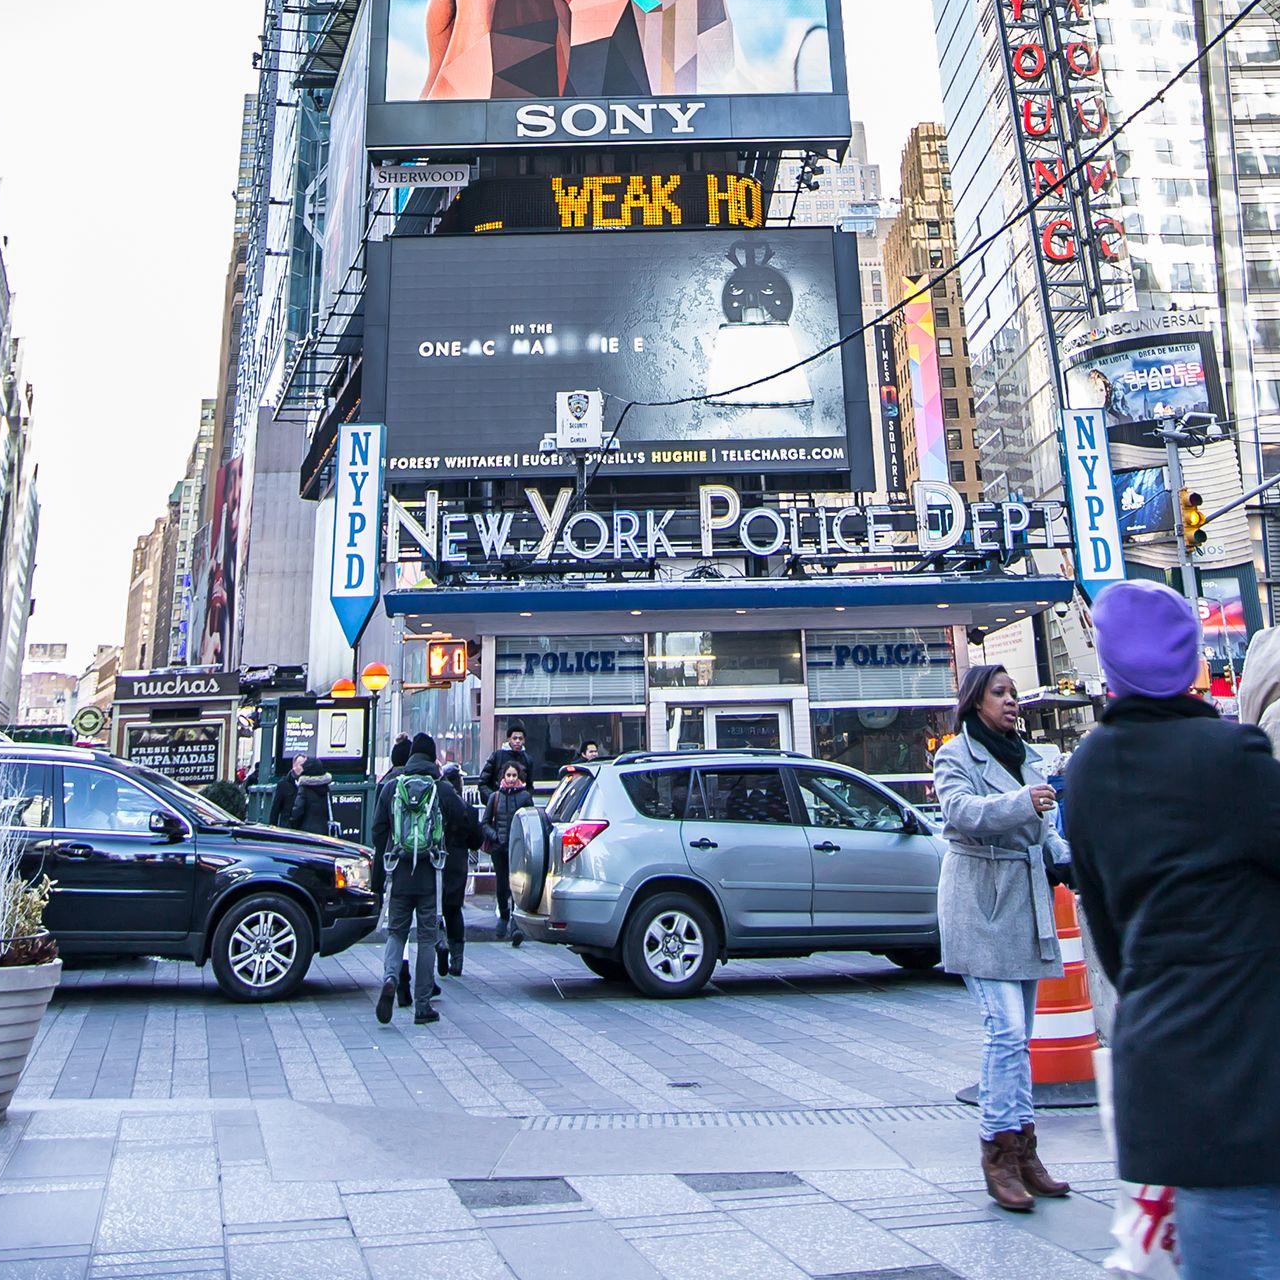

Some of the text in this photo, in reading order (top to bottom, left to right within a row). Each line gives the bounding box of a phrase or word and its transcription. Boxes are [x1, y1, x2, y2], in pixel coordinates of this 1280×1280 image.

[516, 103, 706, 137] SONY
[377, 167, 466, 185] SHERWOOD
[551, 174, 683, 227] WEAK
[510, 323, 553, 334] IN THE
[1105, 314, 1204, 336] NBCUNIVERSAL
[879, 328, 892, 382] TIMES
[1138, 349, 1156, 358] DREA
[1168, 344, 1197, 353] MATTEO
[1123, 362, 1201, 383] SHADES
[1129, 373, 1199, 392] OF BLUE
[389, 447, 845, 470] FOREST WHITAKER HUGHIE TELECHARGE.COM
[887, 420, 899, 488] SQUARE
[1072, 414, 1113, 573] NYPD
[343, 431, 372, 590] NYPD
[386, 479, 1065, 563] NEW YORK POLICE DEPT
[523, 650, 619, 675] POLICE
[833, 642, 928, 668] POLICE
[133, 676, 220, 695] nuchas
[131, 745, 215, 755] FRESH BAKED
[131, 753, 215, 766] EMPANADAS
